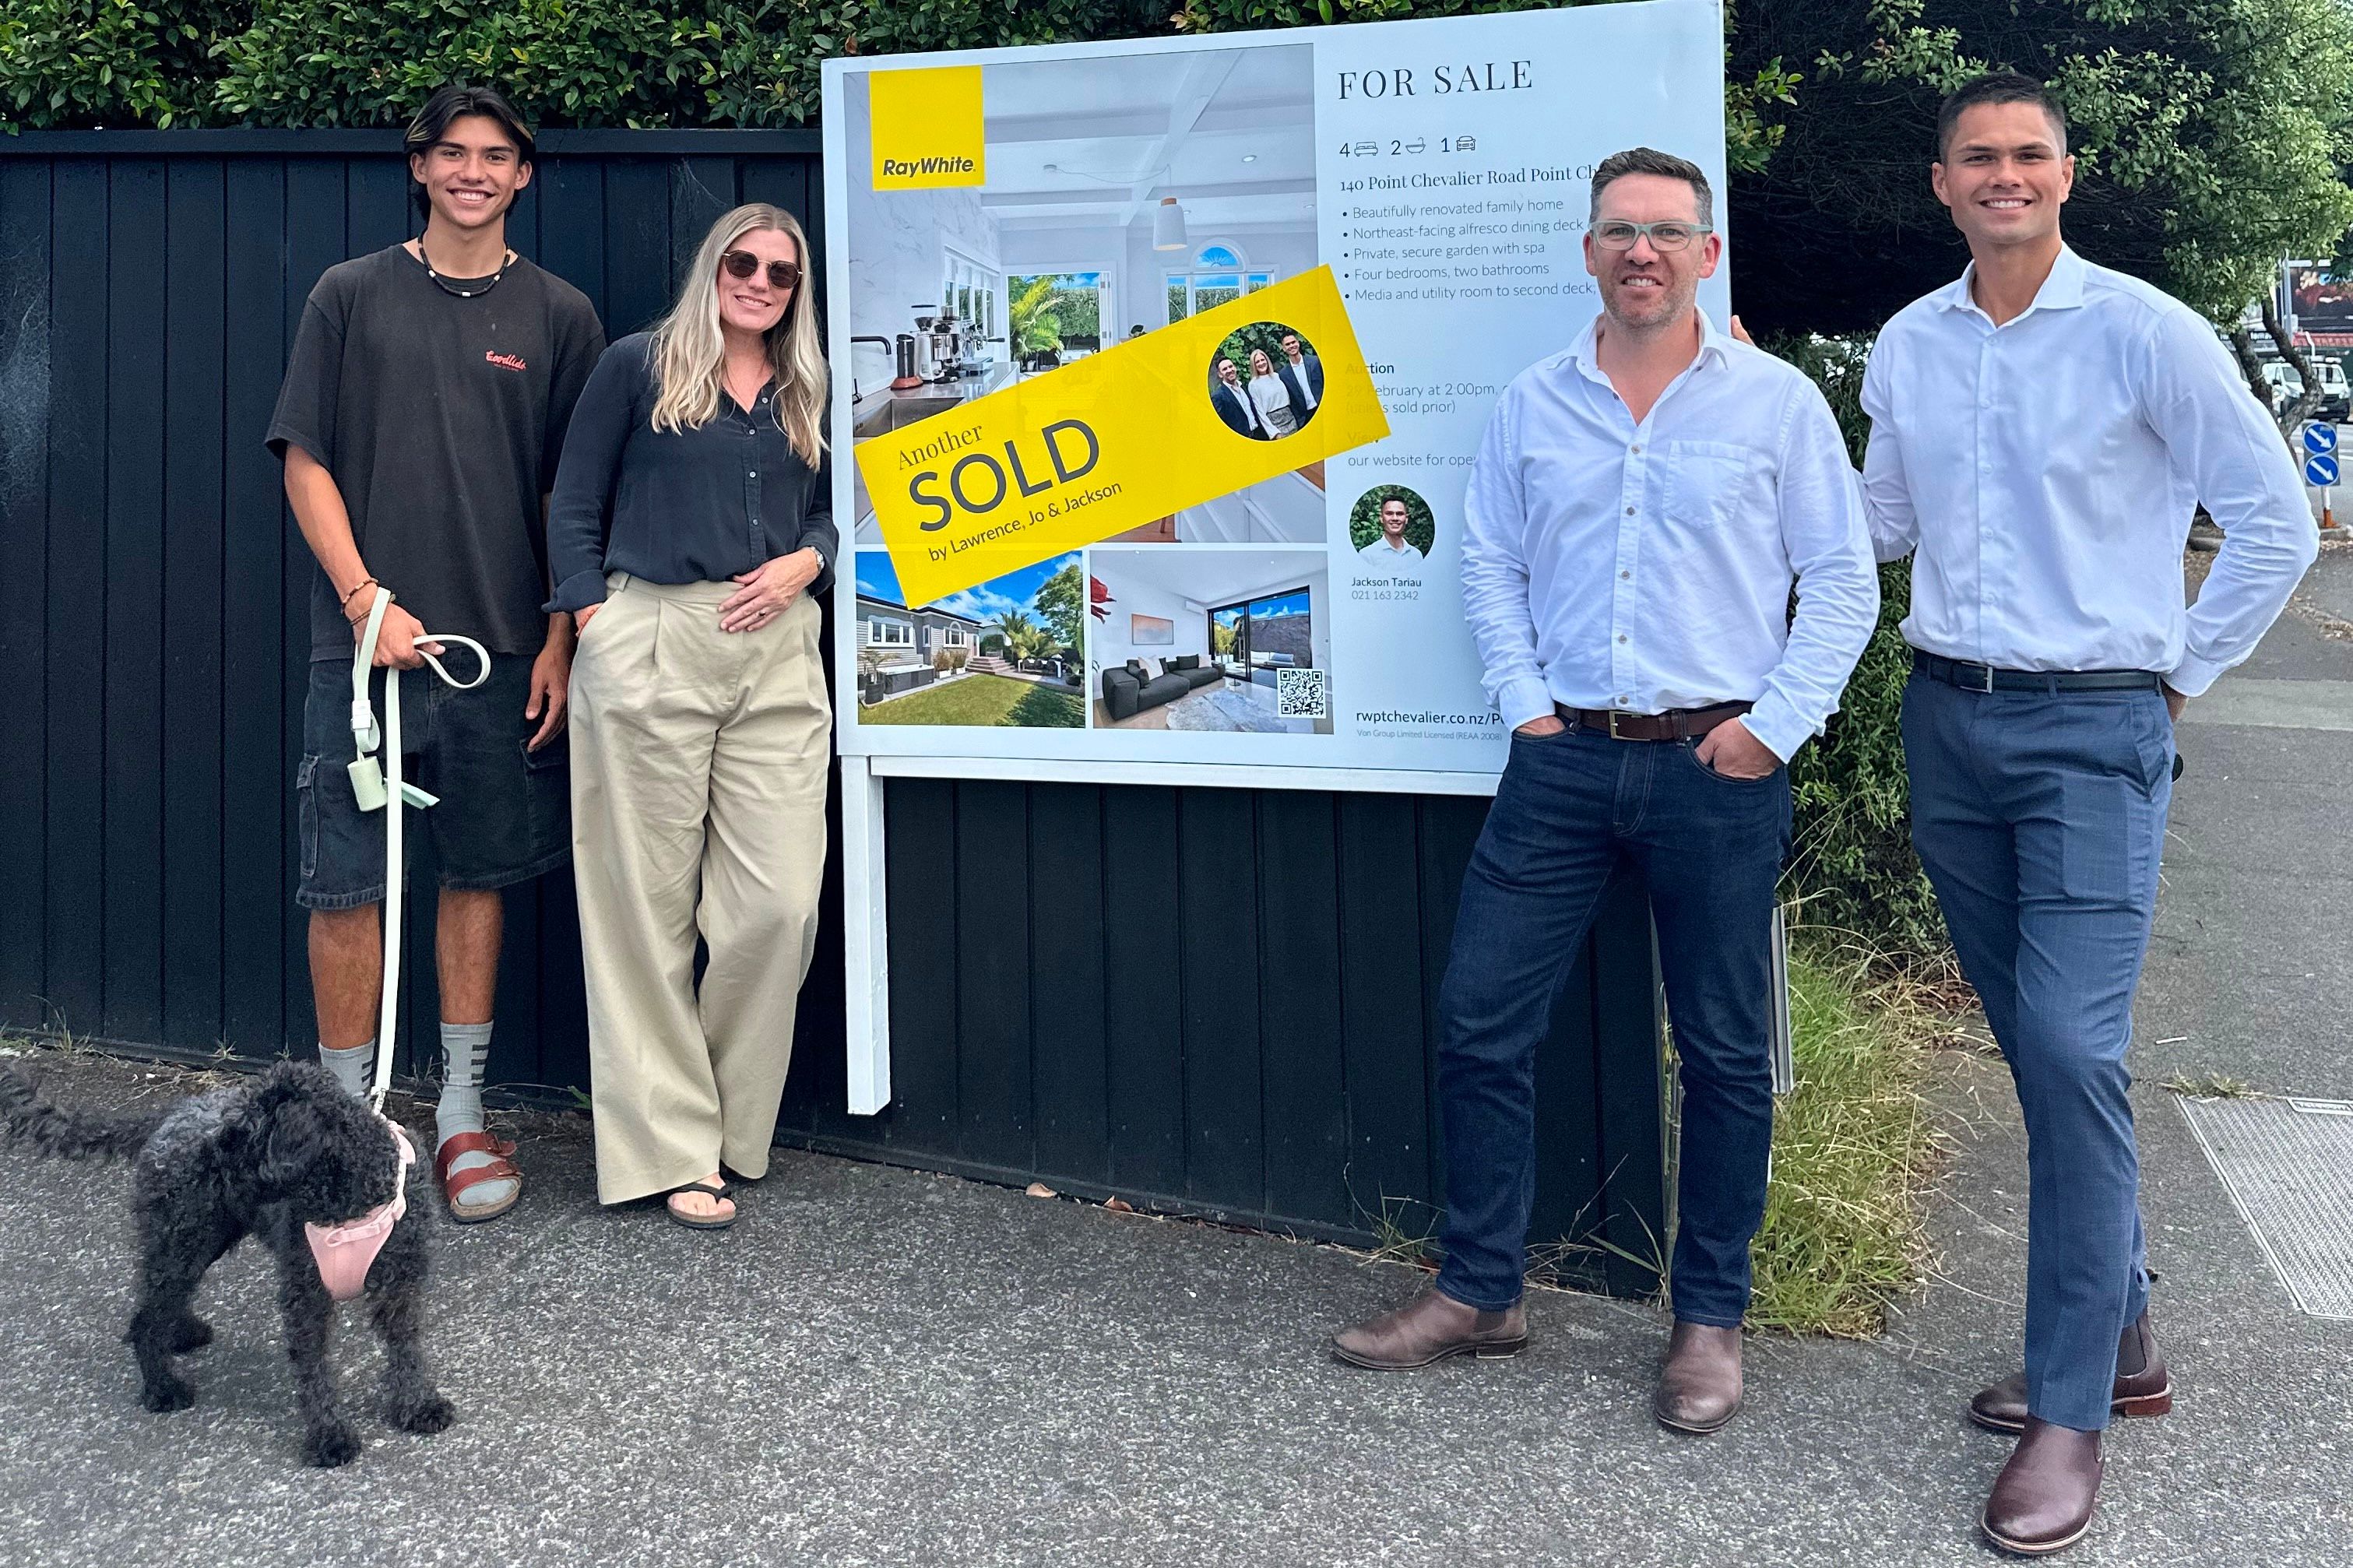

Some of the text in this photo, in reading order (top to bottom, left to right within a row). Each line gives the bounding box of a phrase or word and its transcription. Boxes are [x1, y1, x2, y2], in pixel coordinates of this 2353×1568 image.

[1338, 60, 1533, 100] FOR SALE
[1339, 137, 1450, 157] 4 2 1
[1340, 163, 1597, 192] 140 Point Chevalier Road Point Ch
[1353, 198, 1563, 219] Beautifully renovated family home
[1353, 218, 1584, 239] Northeast-facing alfresco dining deck
[1354, 241, 1545, 261] Private, secure garden with spa
[1355, 263, 1549, 280] Four bedrooms, two bathrooms
[1355, 288, 1392, 301] Media
[1396, 287, 1418, 300] and
[1423, 285, 1457, 301] utility
[1460, 287, 1493, 297] room
[1497, 285, 1510, 297] to
[1514, 283, 1558, 296] second
[1429, 384, 1441, 396] at
[1393, 401, 1417, 413] sold
[1422, 399, 1455, 415] prior)
[899, 424, 982, 471] Another
[1348, 456, 1370, 466] our
[1373, 454, 1422, 466] website
[1426, 453, 1445, 466] for
[909, 418, 1099, 532] SOLD
[928, 481, 1123, 562] by Lawrence, Jo & Jackson
[1351, 577, 1422, 587] Jackson Tariau
[1352, 590, 1419, 601] 021 163 2342
[1397, 730, 1423, 738] Limited
[1424, 731, 1454, 740] Licensed
